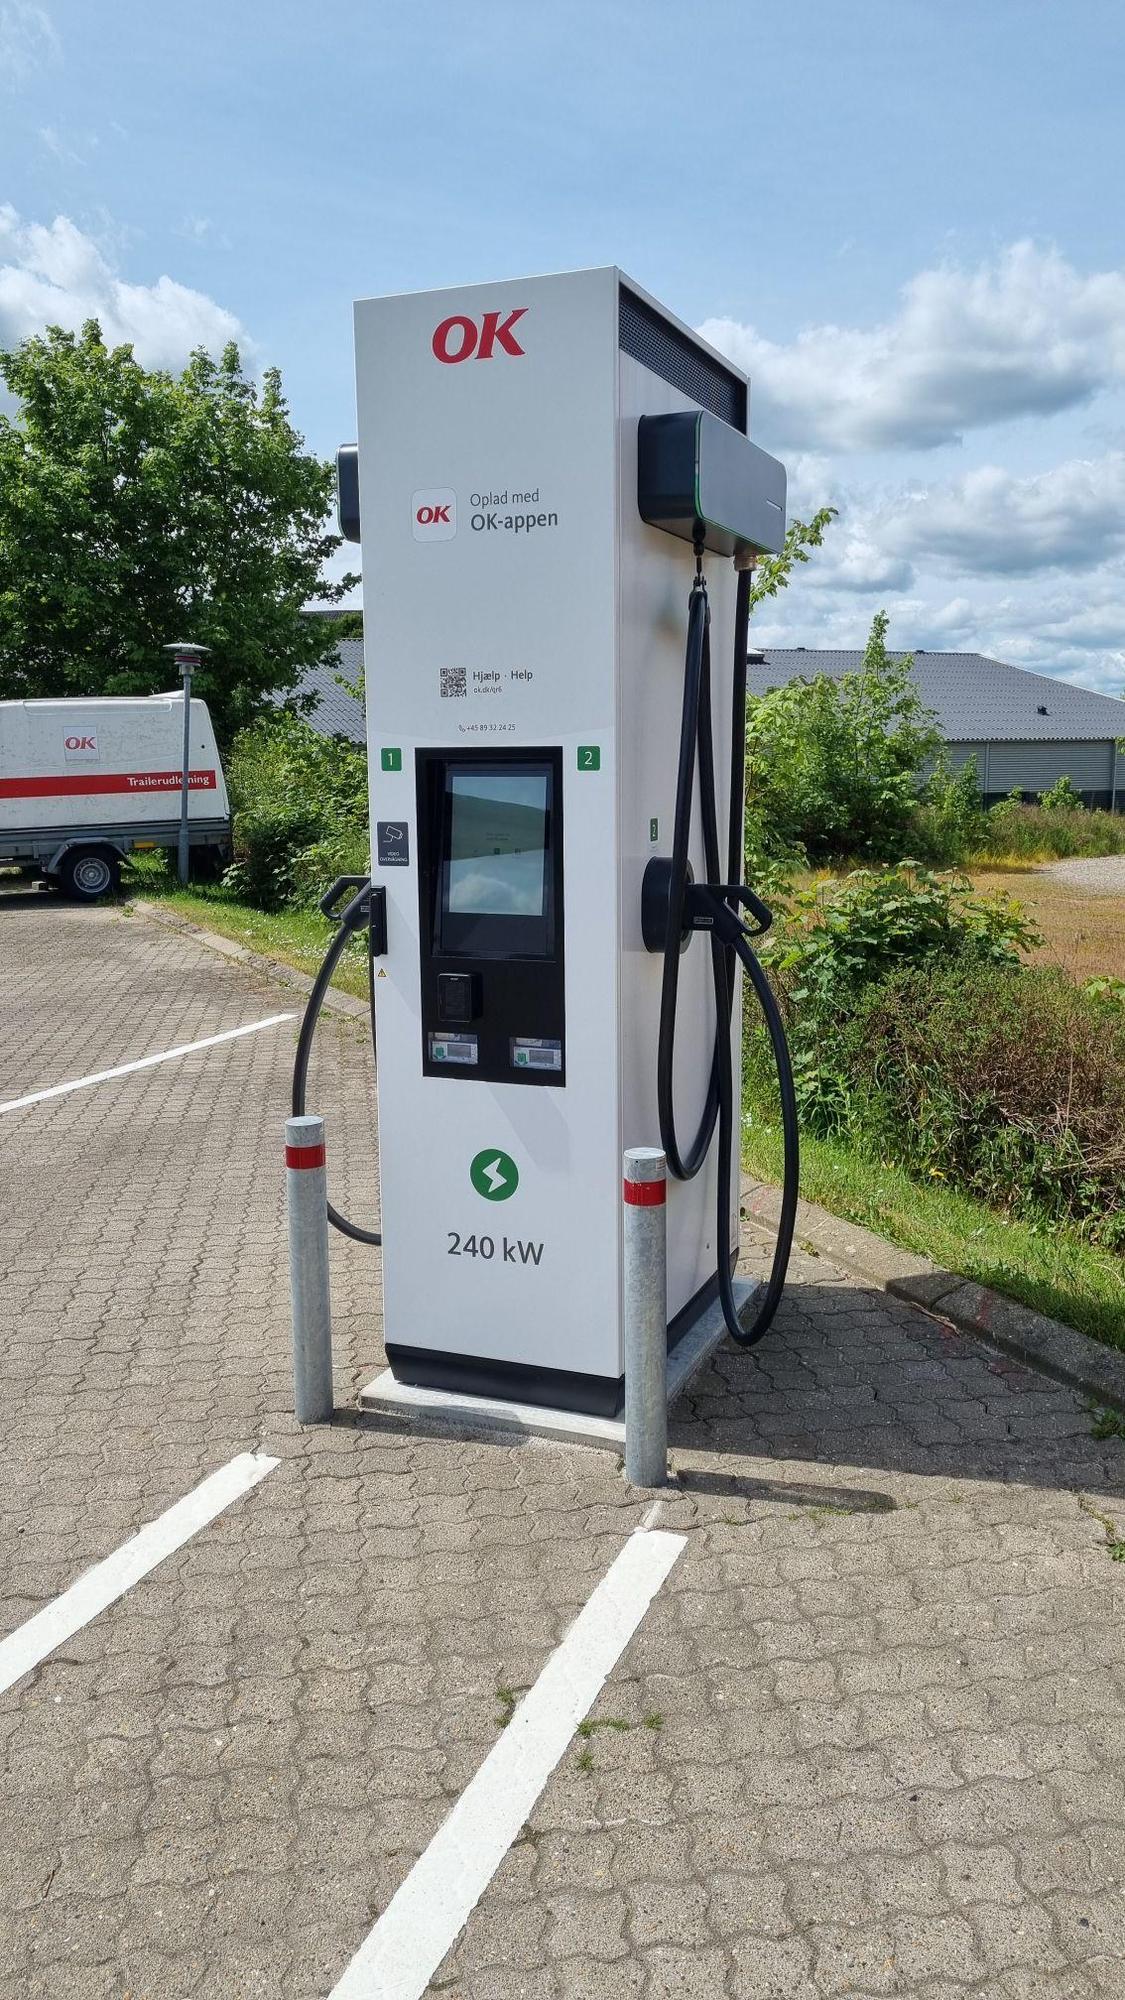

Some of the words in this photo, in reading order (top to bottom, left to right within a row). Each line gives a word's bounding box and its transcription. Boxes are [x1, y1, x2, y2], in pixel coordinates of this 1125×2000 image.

[431, 307, 529, 364] OK
[470, 490, 508, 509] Oplad
[512, 488, 539, 503] med
[416, 505, 451, 524] OK
[471, 513, 558, 533] OK-appen
[472, 670, 501, 683] Hjælp
[511, 669, 533, 681] Help
[508, 723, 516, 731] 25
[65, 736, 96, 750] OK
[387, 753, 394, 766] 1
[584, 751, 593, 765] 2
[127, 775, 210, 787] Trailerudlening
[447, 1232, 495, 1260] 240
[503, 1236, 545, 1266] kW
